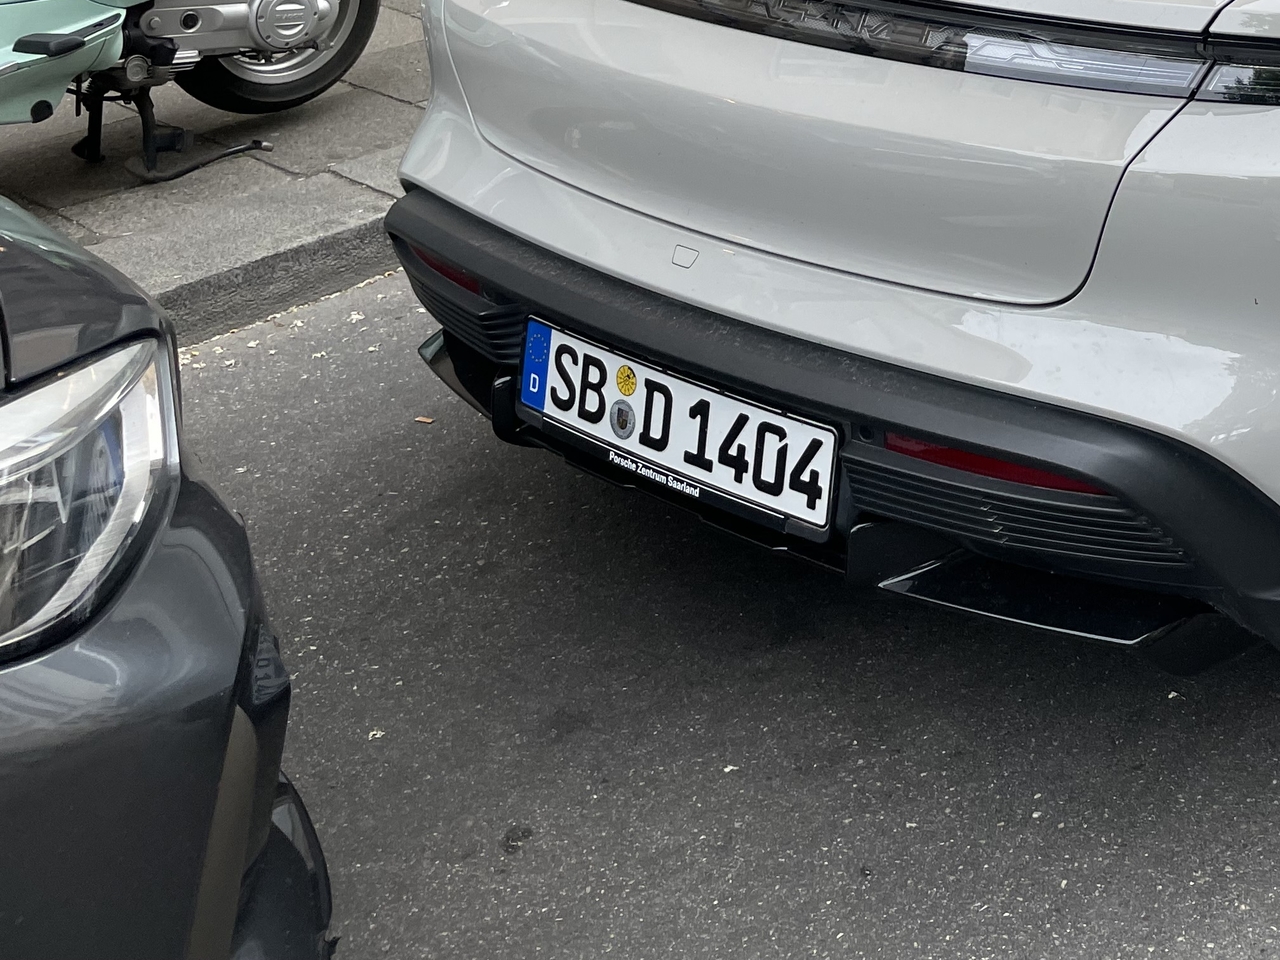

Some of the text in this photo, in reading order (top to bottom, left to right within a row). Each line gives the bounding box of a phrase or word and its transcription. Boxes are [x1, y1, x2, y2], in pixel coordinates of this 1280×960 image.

[529, 373, 538, 393] D
[550, 343, 824, 511] SB D 1404
[609, 450, 700, 498] Porsche Zentrum Saarland
